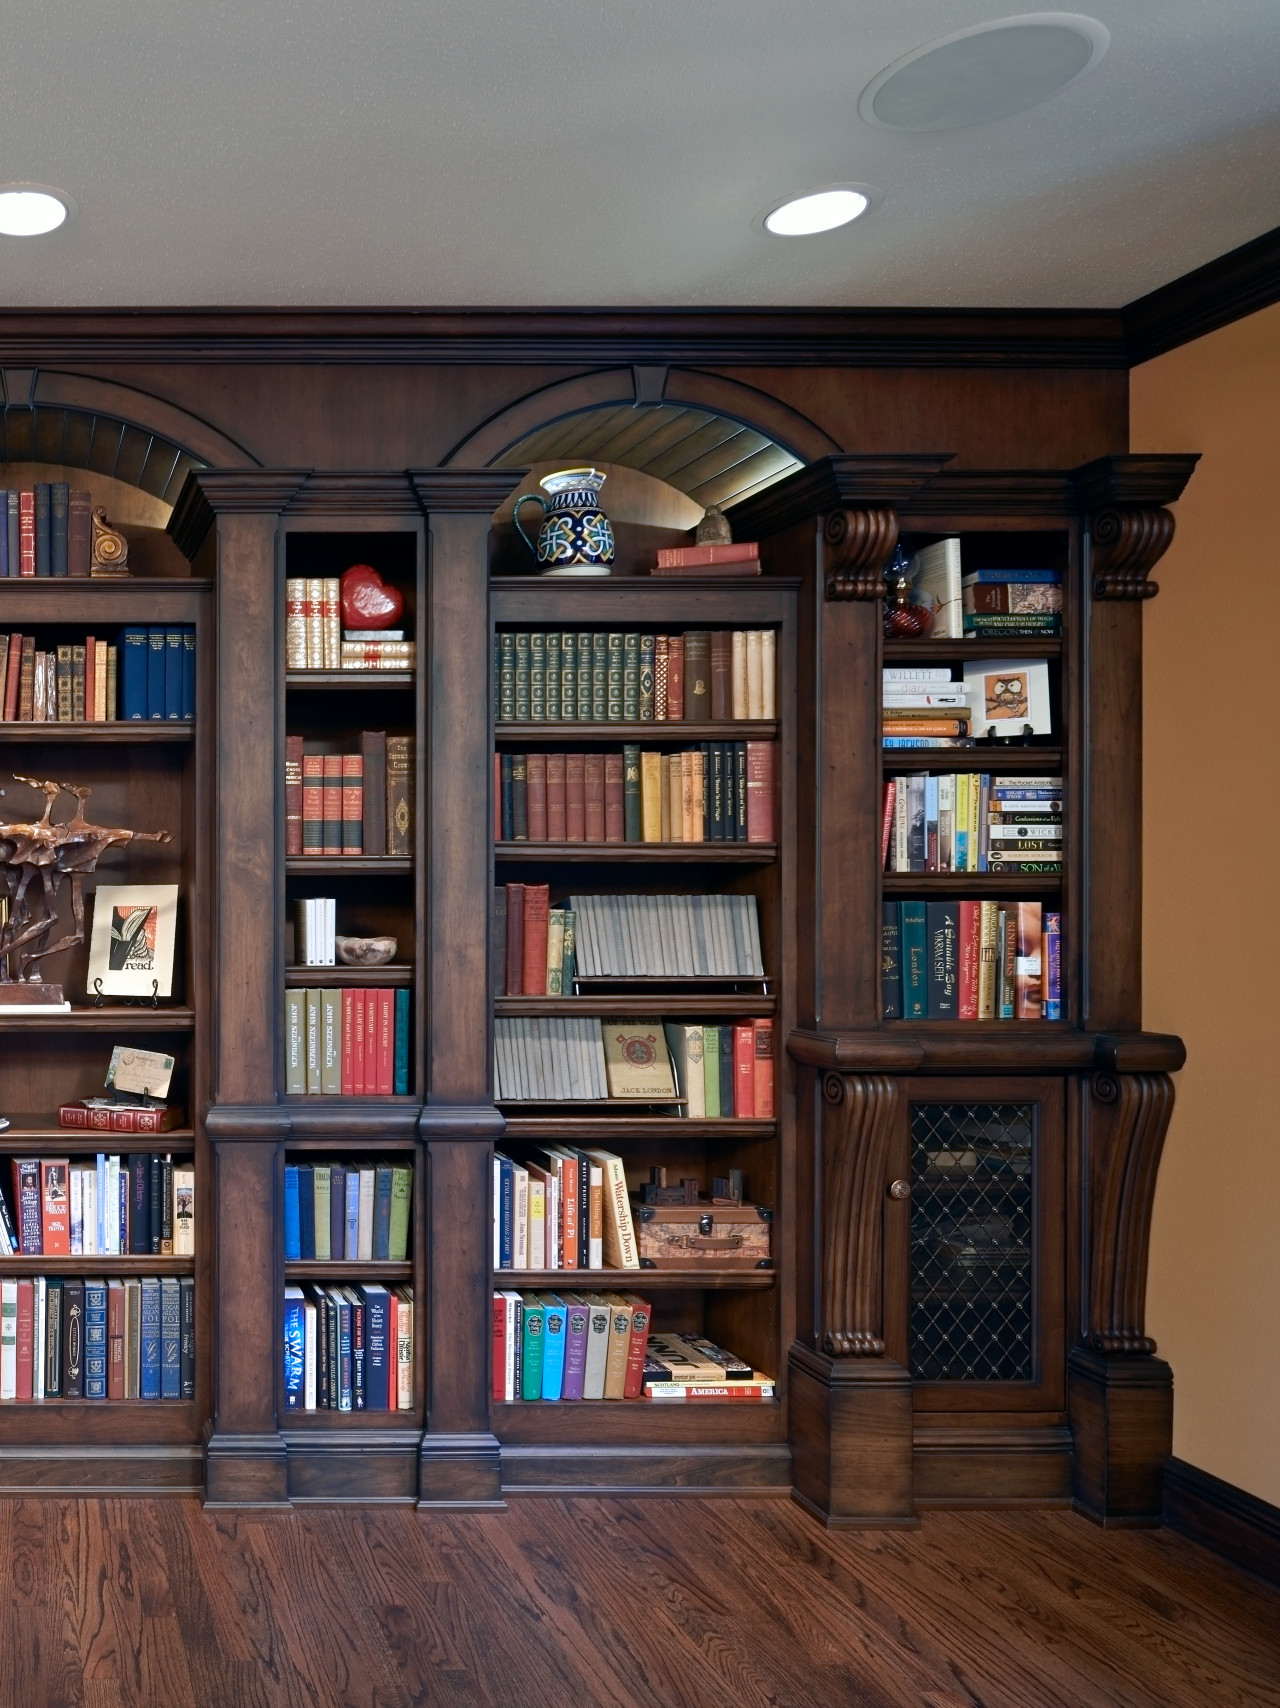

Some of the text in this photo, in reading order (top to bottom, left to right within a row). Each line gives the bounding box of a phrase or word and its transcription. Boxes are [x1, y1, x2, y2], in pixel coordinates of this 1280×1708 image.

[891, 671, 932, 680] WILLETT
[902, 684, 927, 694] diary
[1018, 841, 1044, 849] LOST
[982, 905, 990, 945] ATWOOD
[934, 929, 944, 981] VIKRAM SETH
[1006, 922, 1015, 976] KINFLICKS
[125, 961, 153, 971] read.
[911, 947, 924, 986] London
[607, 1019, 617, 1027] OF
[633, 1018, 660, 1026] WILD
[620, 1087, 641, 1095] JACK
[614, 1181, 632, 1231] Watership
[622, 1233, 634, 1262] Down
[287, 1307, 302, 1390] THE SWARM
